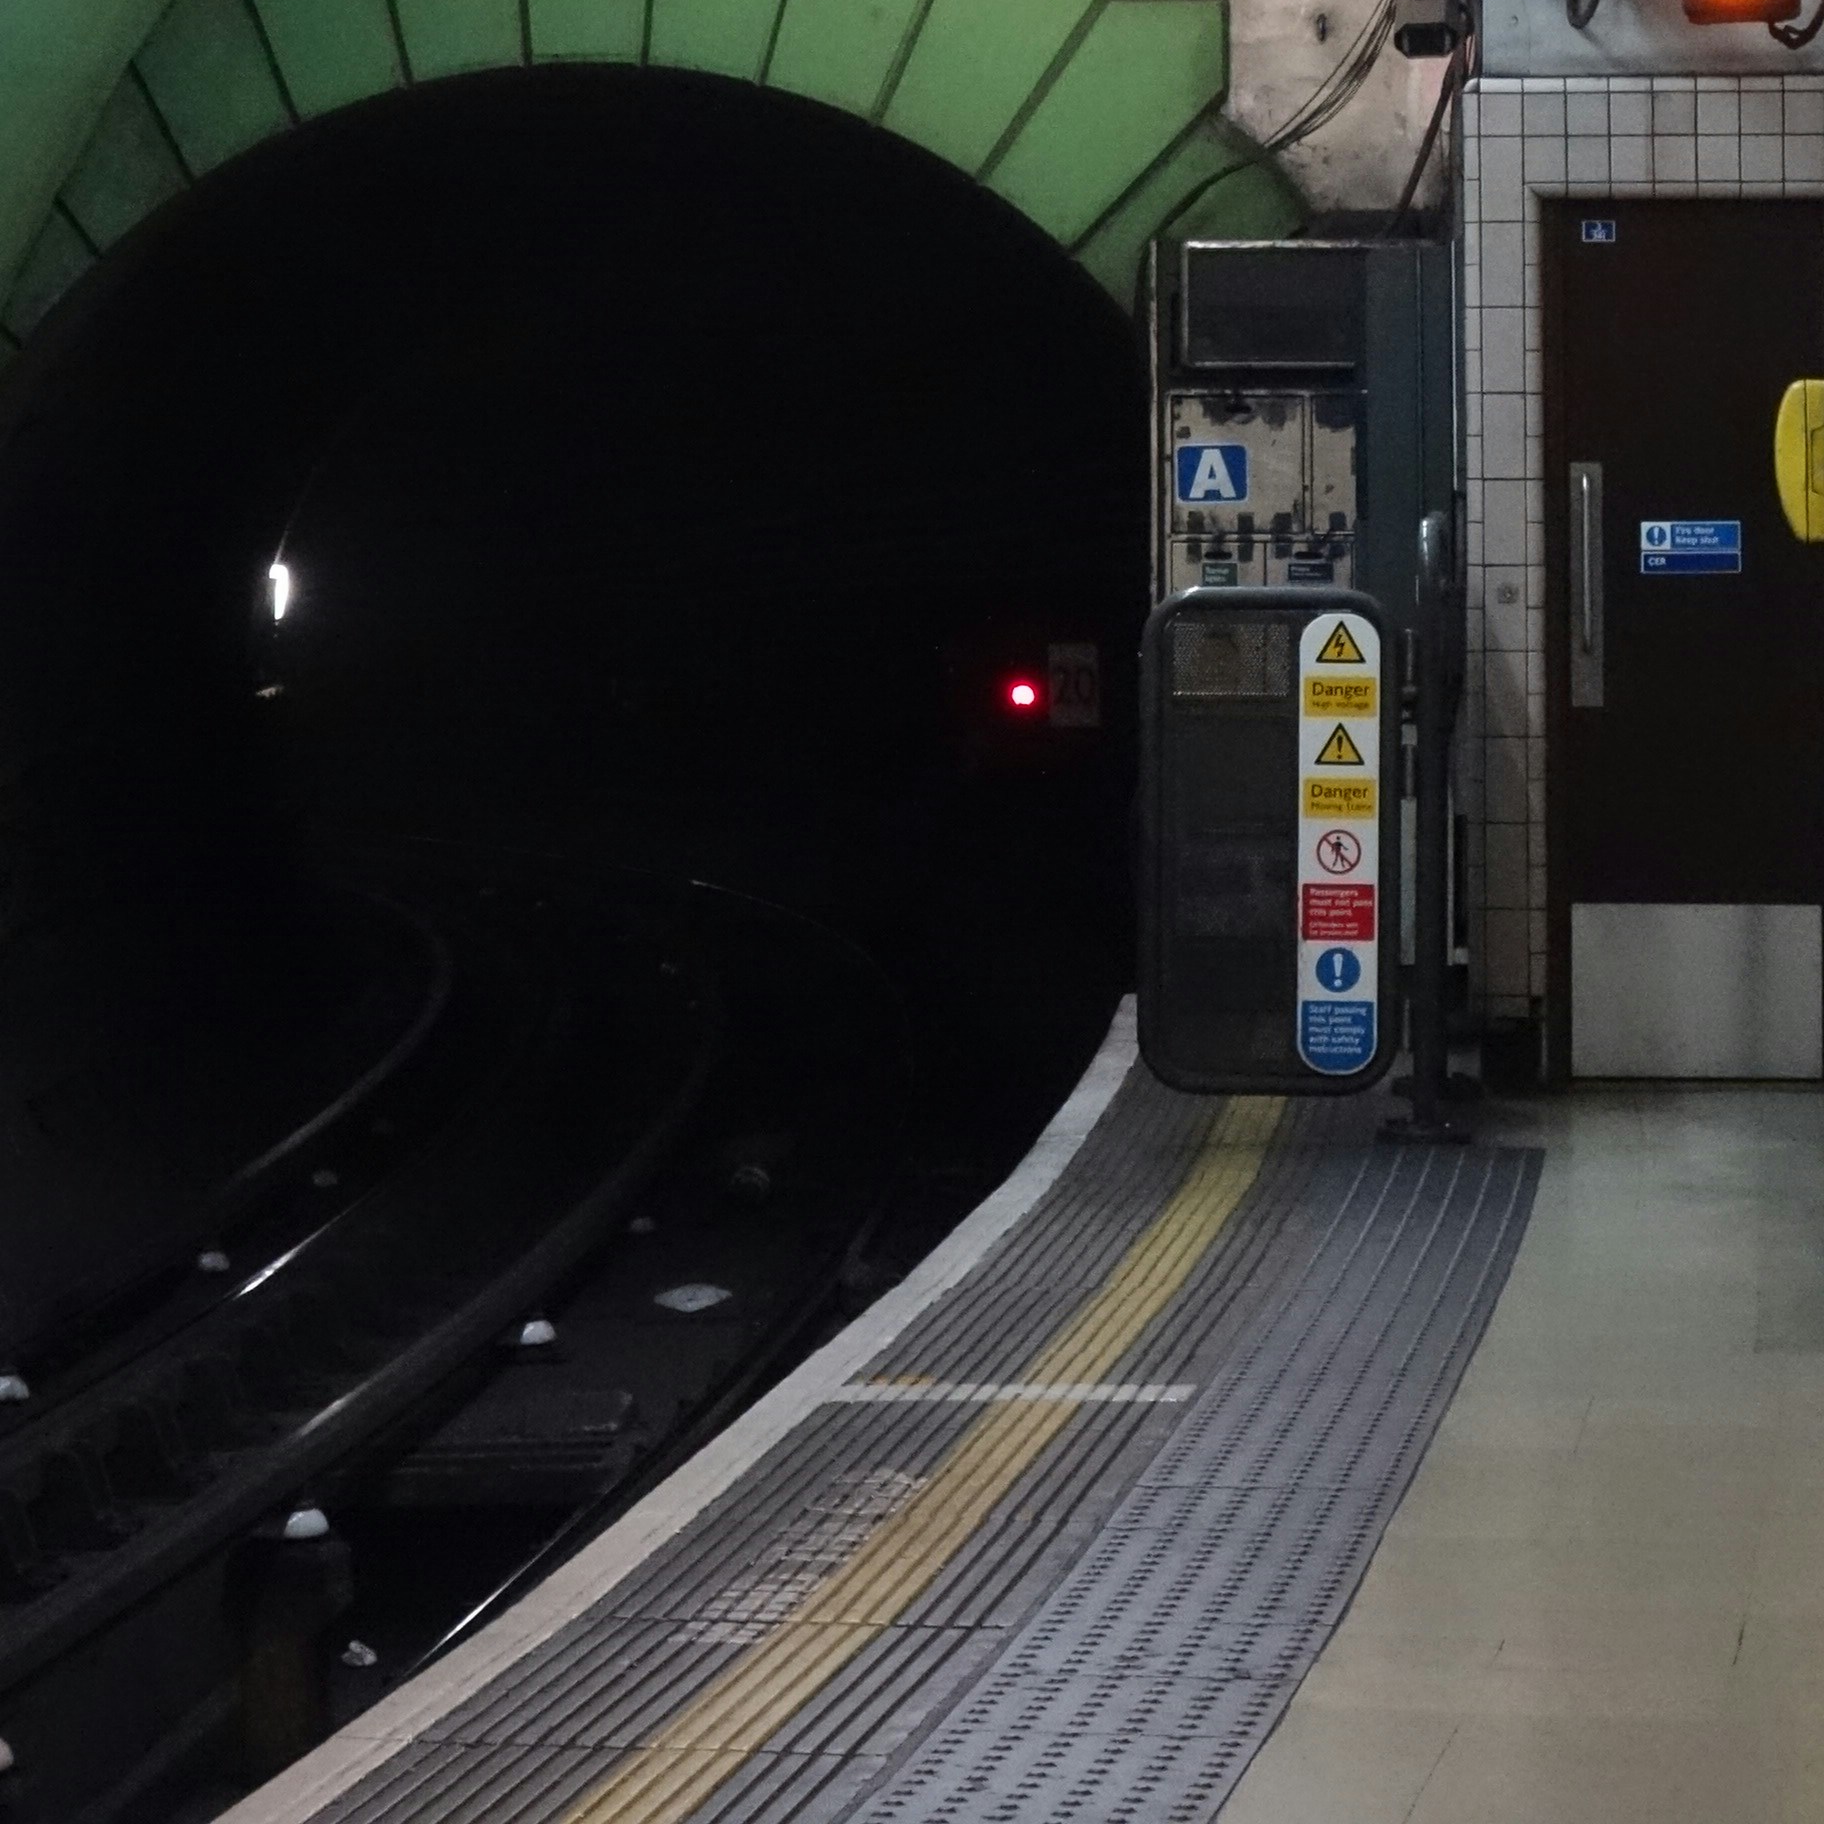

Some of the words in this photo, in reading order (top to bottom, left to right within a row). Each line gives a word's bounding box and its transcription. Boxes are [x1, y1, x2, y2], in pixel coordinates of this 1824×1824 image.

[1188, 449, 1237, 499] A
[1312, 682, 1370, 701] Danger
[1311, 784, 1368, 803] Danger
